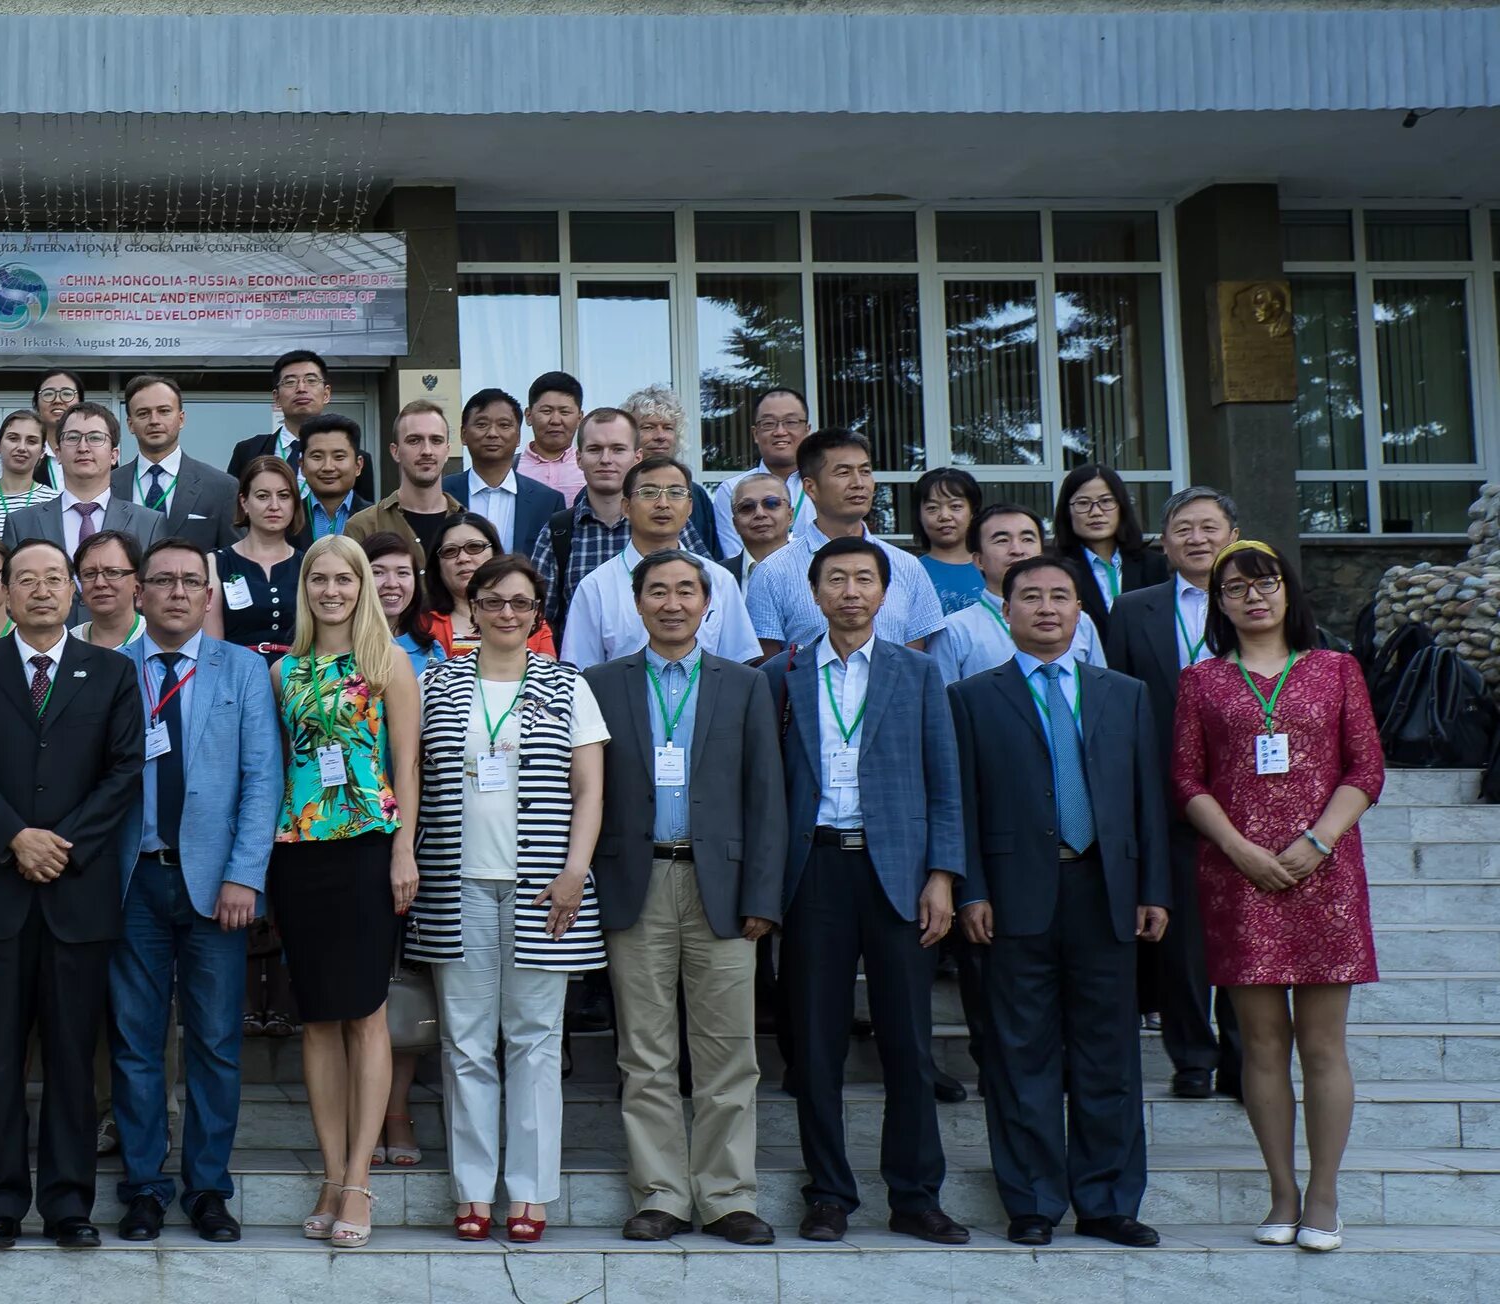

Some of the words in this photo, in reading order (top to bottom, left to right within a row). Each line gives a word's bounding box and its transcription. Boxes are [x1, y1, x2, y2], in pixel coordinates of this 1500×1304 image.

[23, 243, 118, 253] INTERNATIONAL
[124, 244, 203, 253] GEOGRAPHIC
[207, 244, 284, 253] CONFERENCE
[248, 275, 317, 286] ECONOMIC
[58, 292, 157, 304] GEOGRAPHICAL
[159, 292, 186, 304] AND
[188, 292, 295, 304] ENVIRONMENTAL
[298, 291, 356, 304] FACTORS
[357, 291, 377, 304] OF
[58, 309, 142, 321] TERRITORIAL
[145, 309, 242, 321] DEVELOPMENT
[23, 337, 70, 349] Irkutsk,
[74, 337, 116, 351] August
[118, 337, 152, 350] 20-26,
[155, 337, 181, 348] 2018
